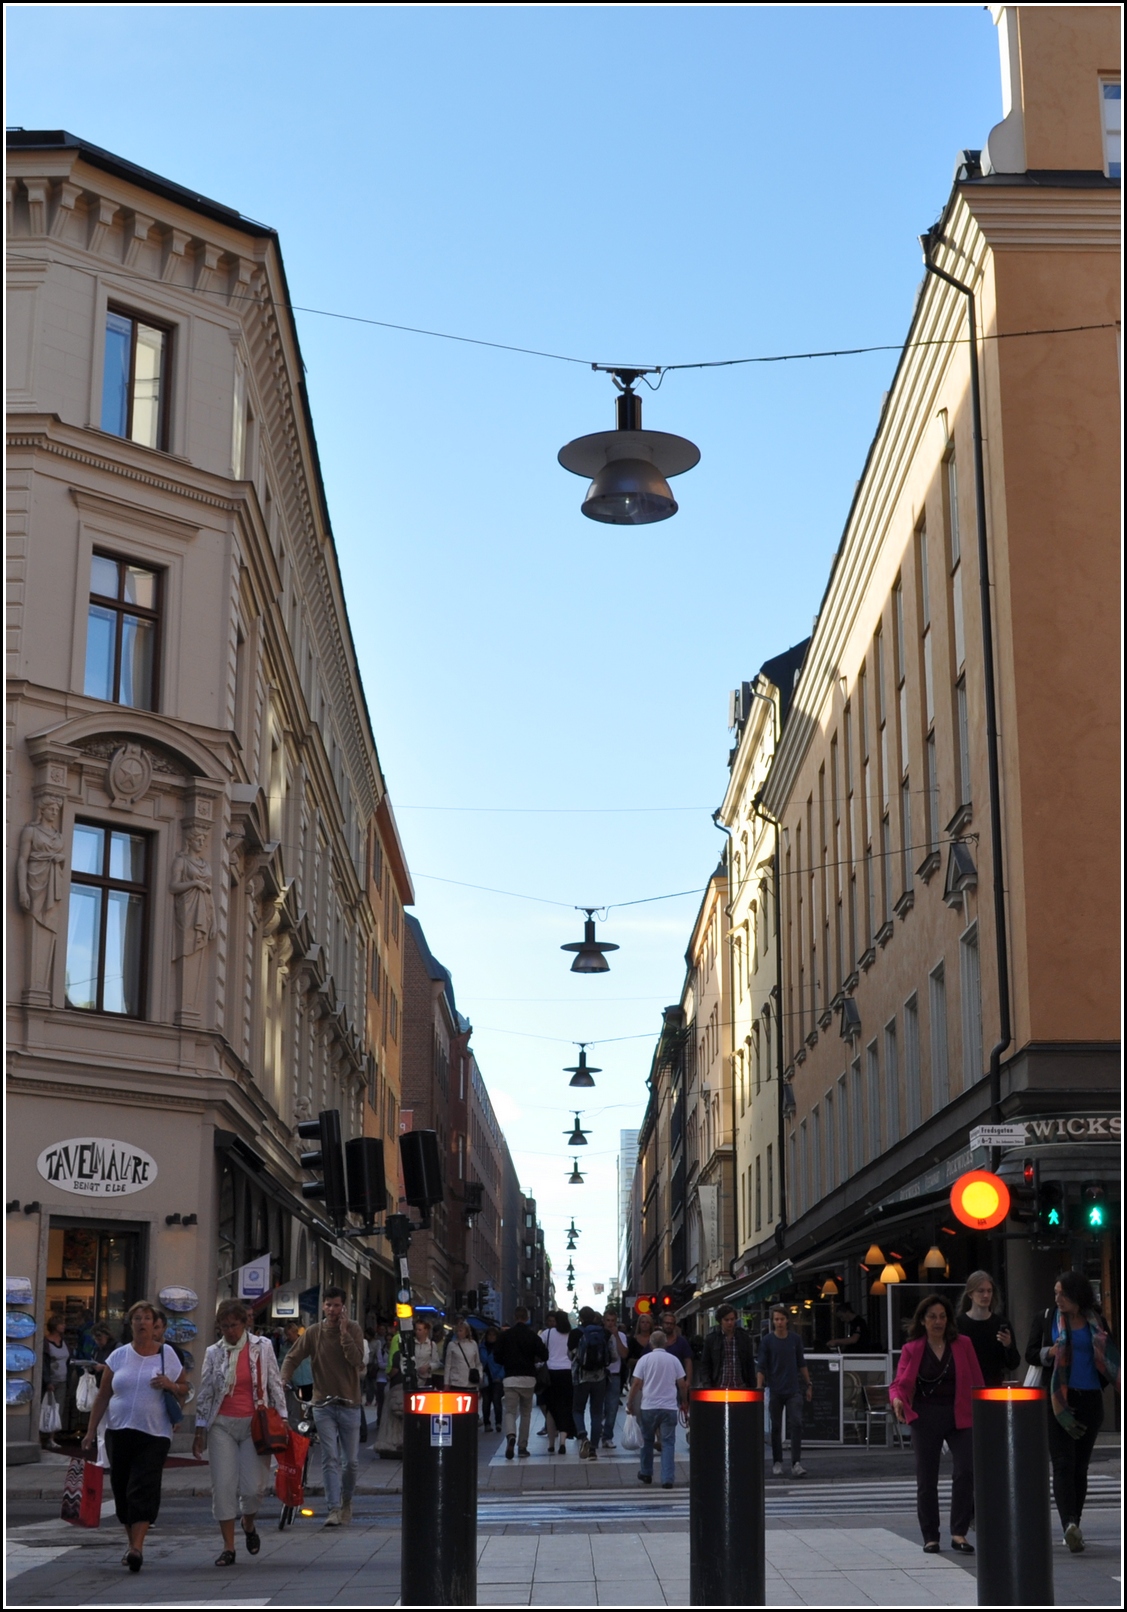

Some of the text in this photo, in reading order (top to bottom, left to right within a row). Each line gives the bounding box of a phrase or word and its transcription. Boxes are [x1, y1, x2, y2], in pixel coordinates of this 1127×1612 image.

[981, 1126, 1014, 1135] Fredsgatan
[45, 1141, 150, 1184] TAVELMÅLARE
[73, 1181, 126, 1192] BENGT ELDE
[410, 1395, 472, 1412] 17 17
